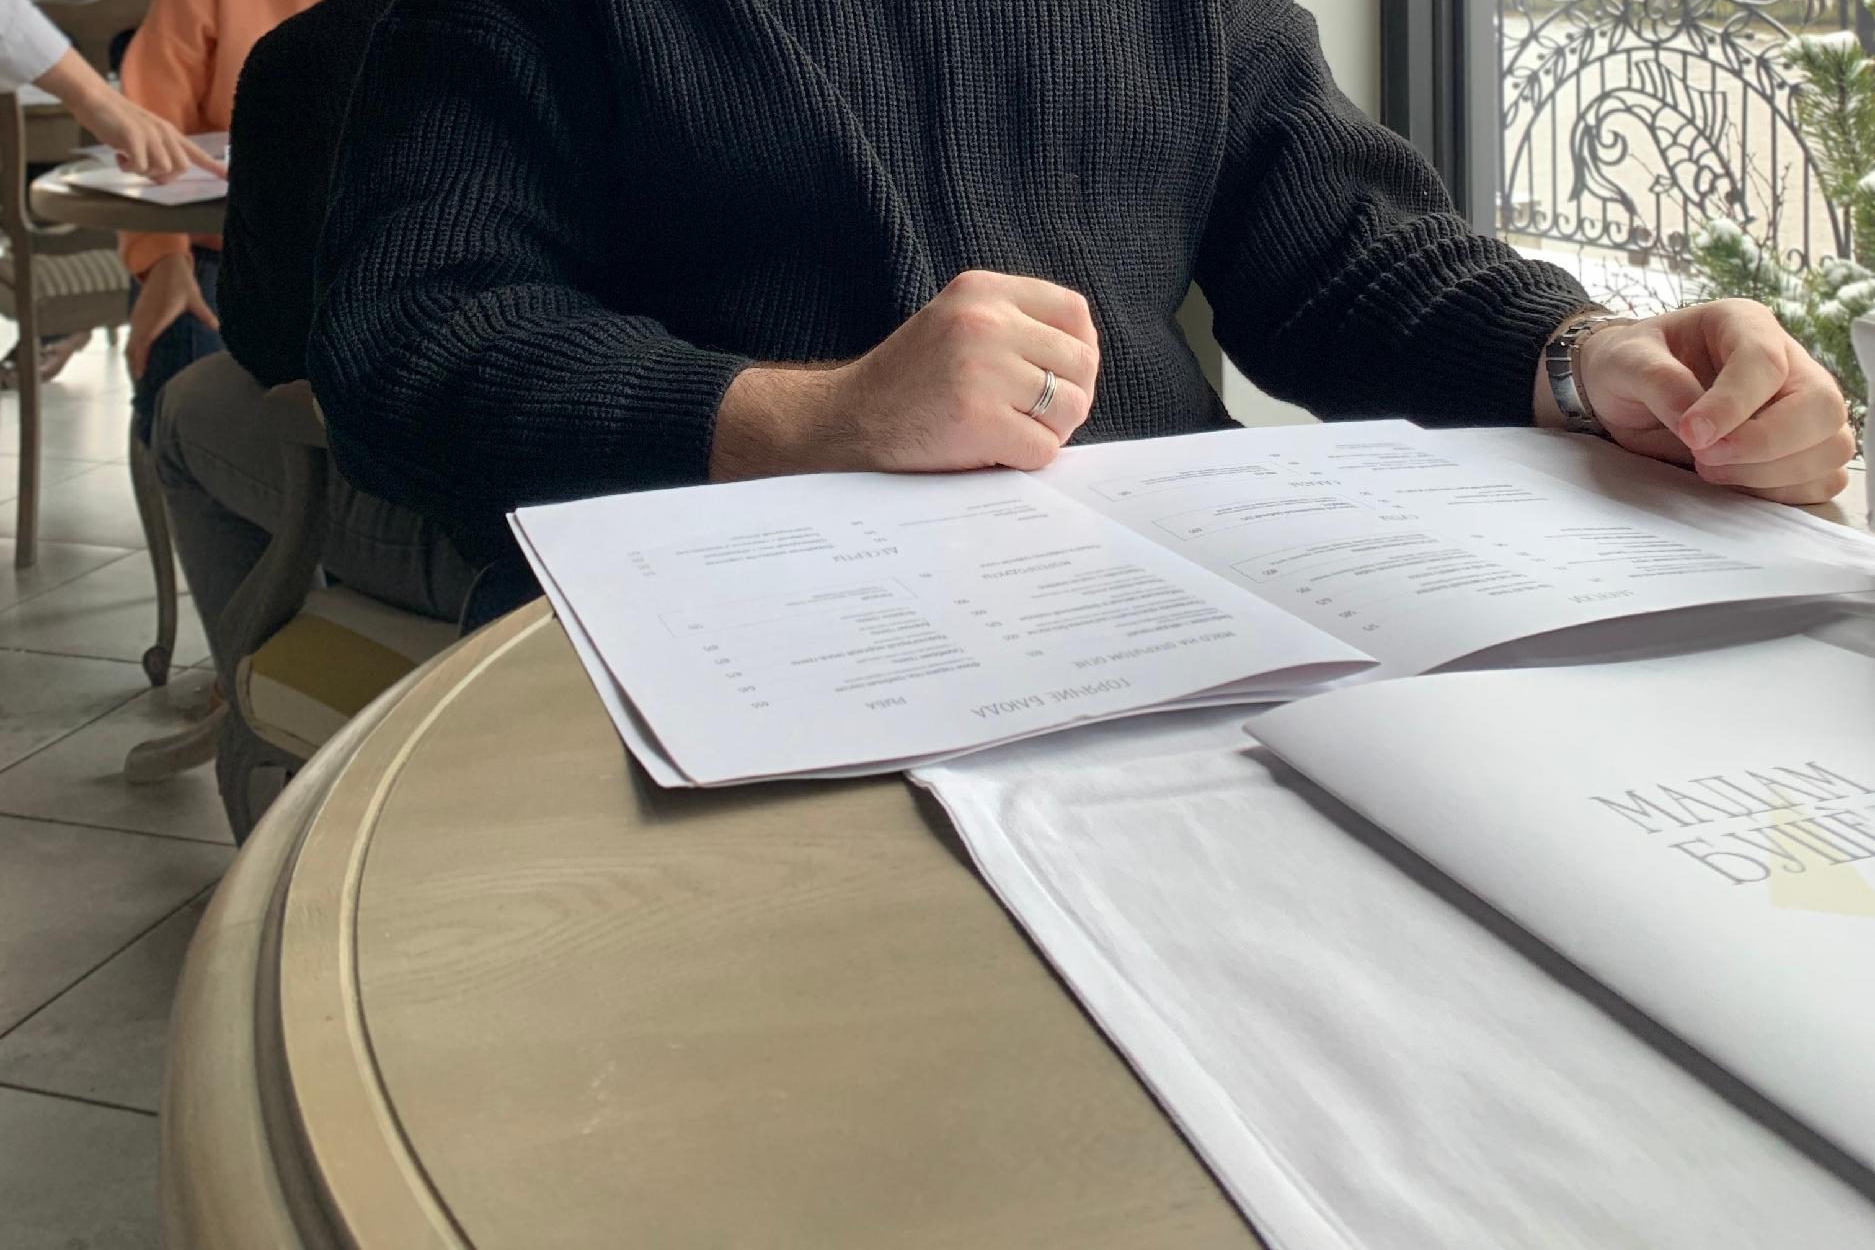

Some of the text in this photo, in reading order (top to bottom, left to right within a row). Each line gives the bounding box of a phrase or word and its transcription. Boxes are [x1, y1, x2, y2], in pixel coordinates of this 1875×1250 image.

[971, 676, 1131, 719] ГОРЯЧИЕ БЛЮДА
[1587, 761, 1875, 835] МАДАМ
